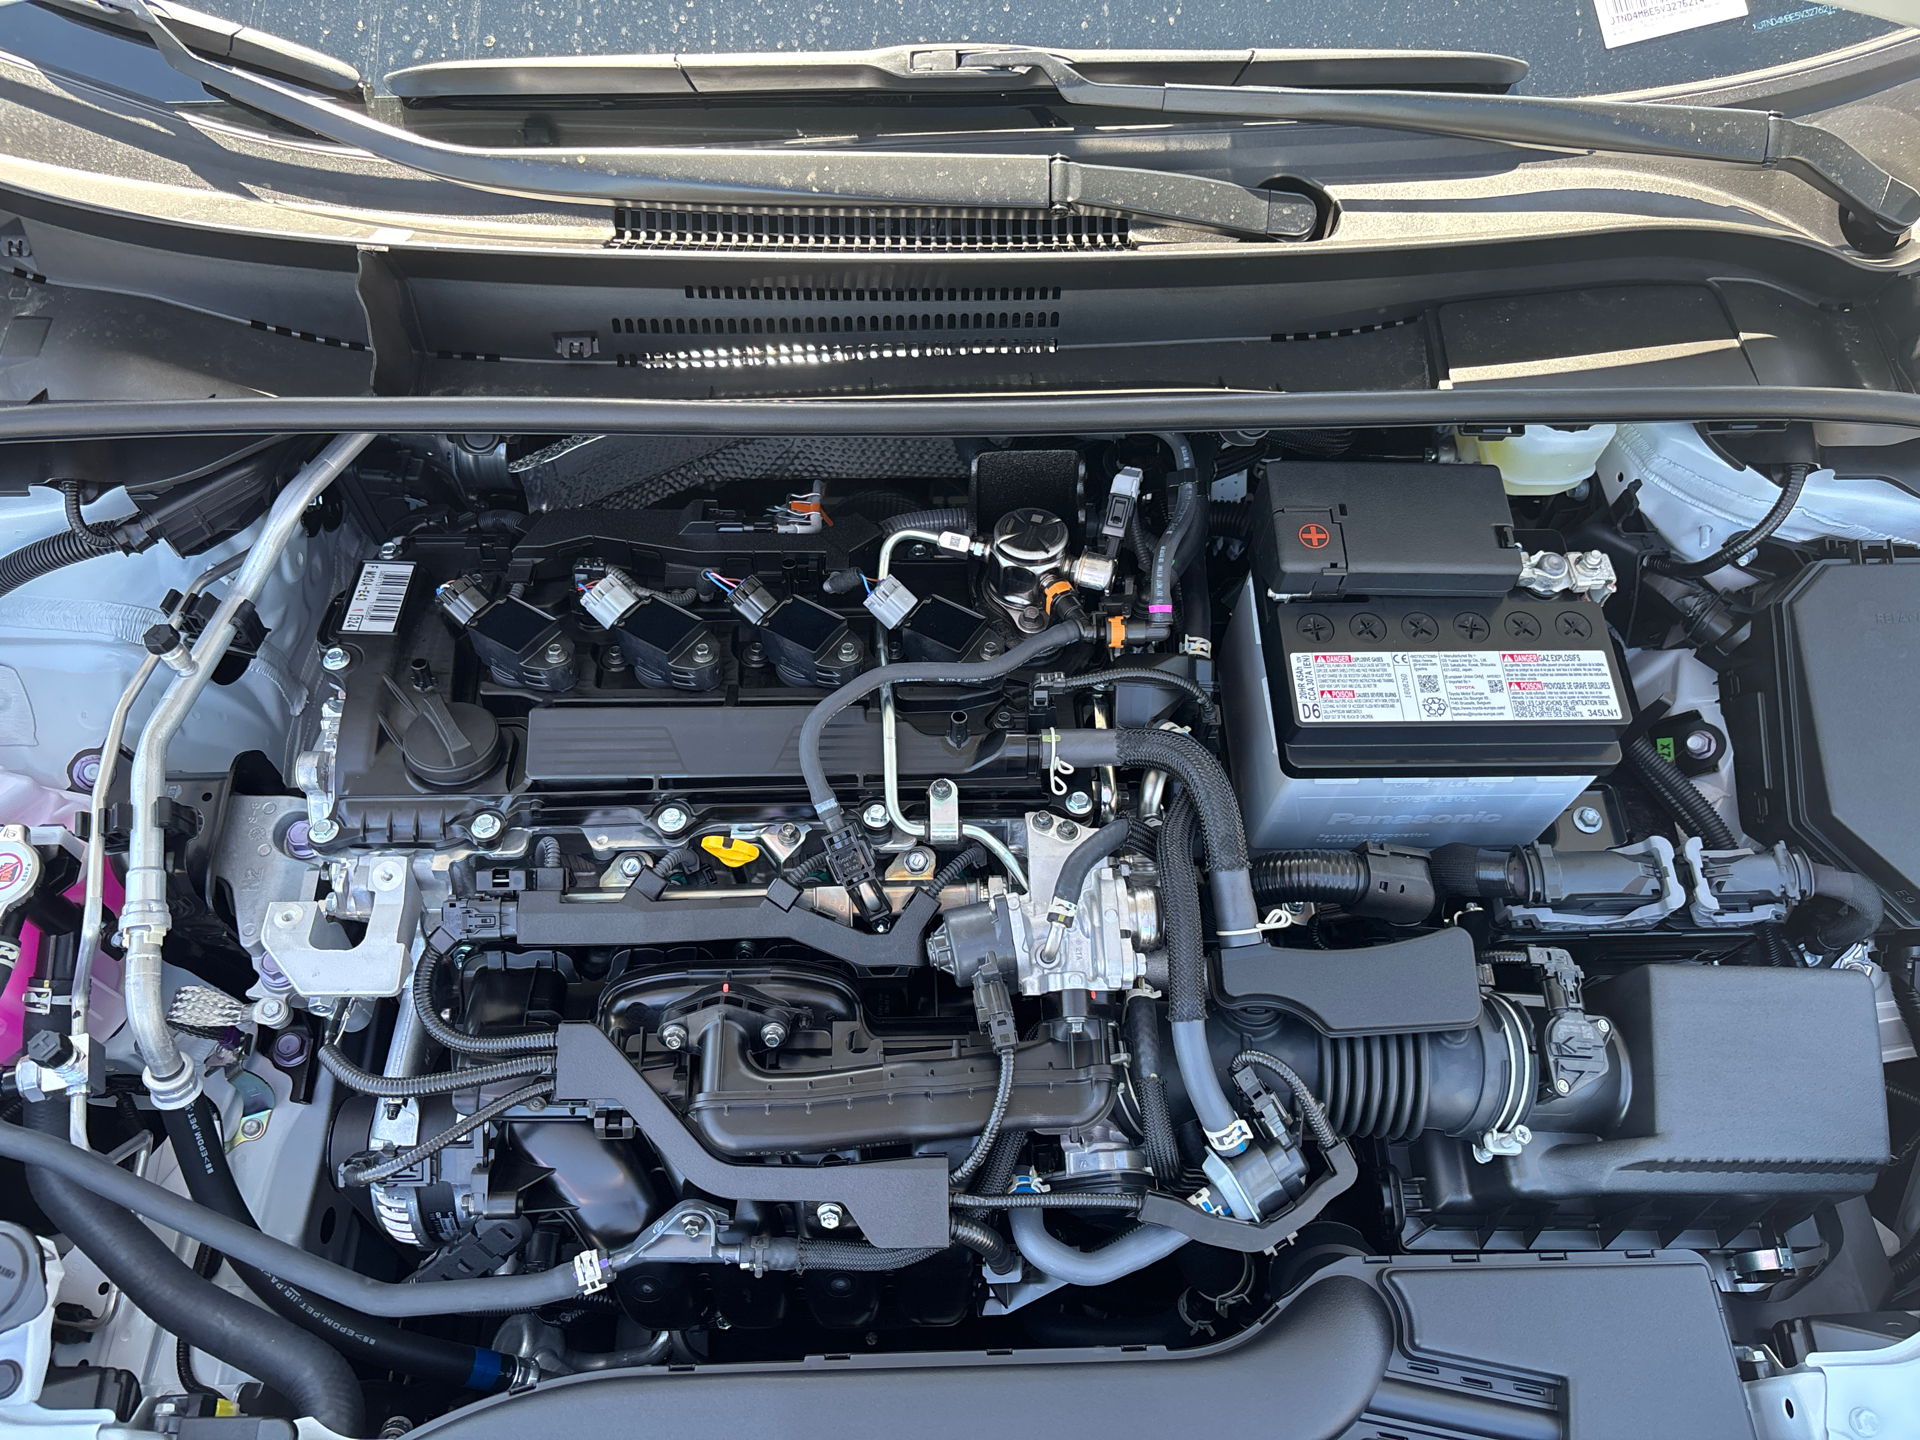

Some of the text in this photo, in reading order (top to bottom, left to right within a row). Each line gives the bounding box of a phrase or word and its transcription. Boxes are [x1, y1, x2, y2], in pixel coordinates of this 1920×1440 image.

[1875, 611, 1912, 624] RELAY
[1326, 655, 1351, 663] DANGER
[1513, 654, 1538, 662] DANGER
[1520, 682, 1543, 690] POISON
[1307, 687, 1317, 701] CCA
[1331, 690, 1354, 698] POISON
[1302, 703, 1321, 719] D6
[1587, 709, 1619, 717] 345LN1
[1383, 796, 1430, 804] LOWER
[1327, 810, 1502, 825] Panasonic
